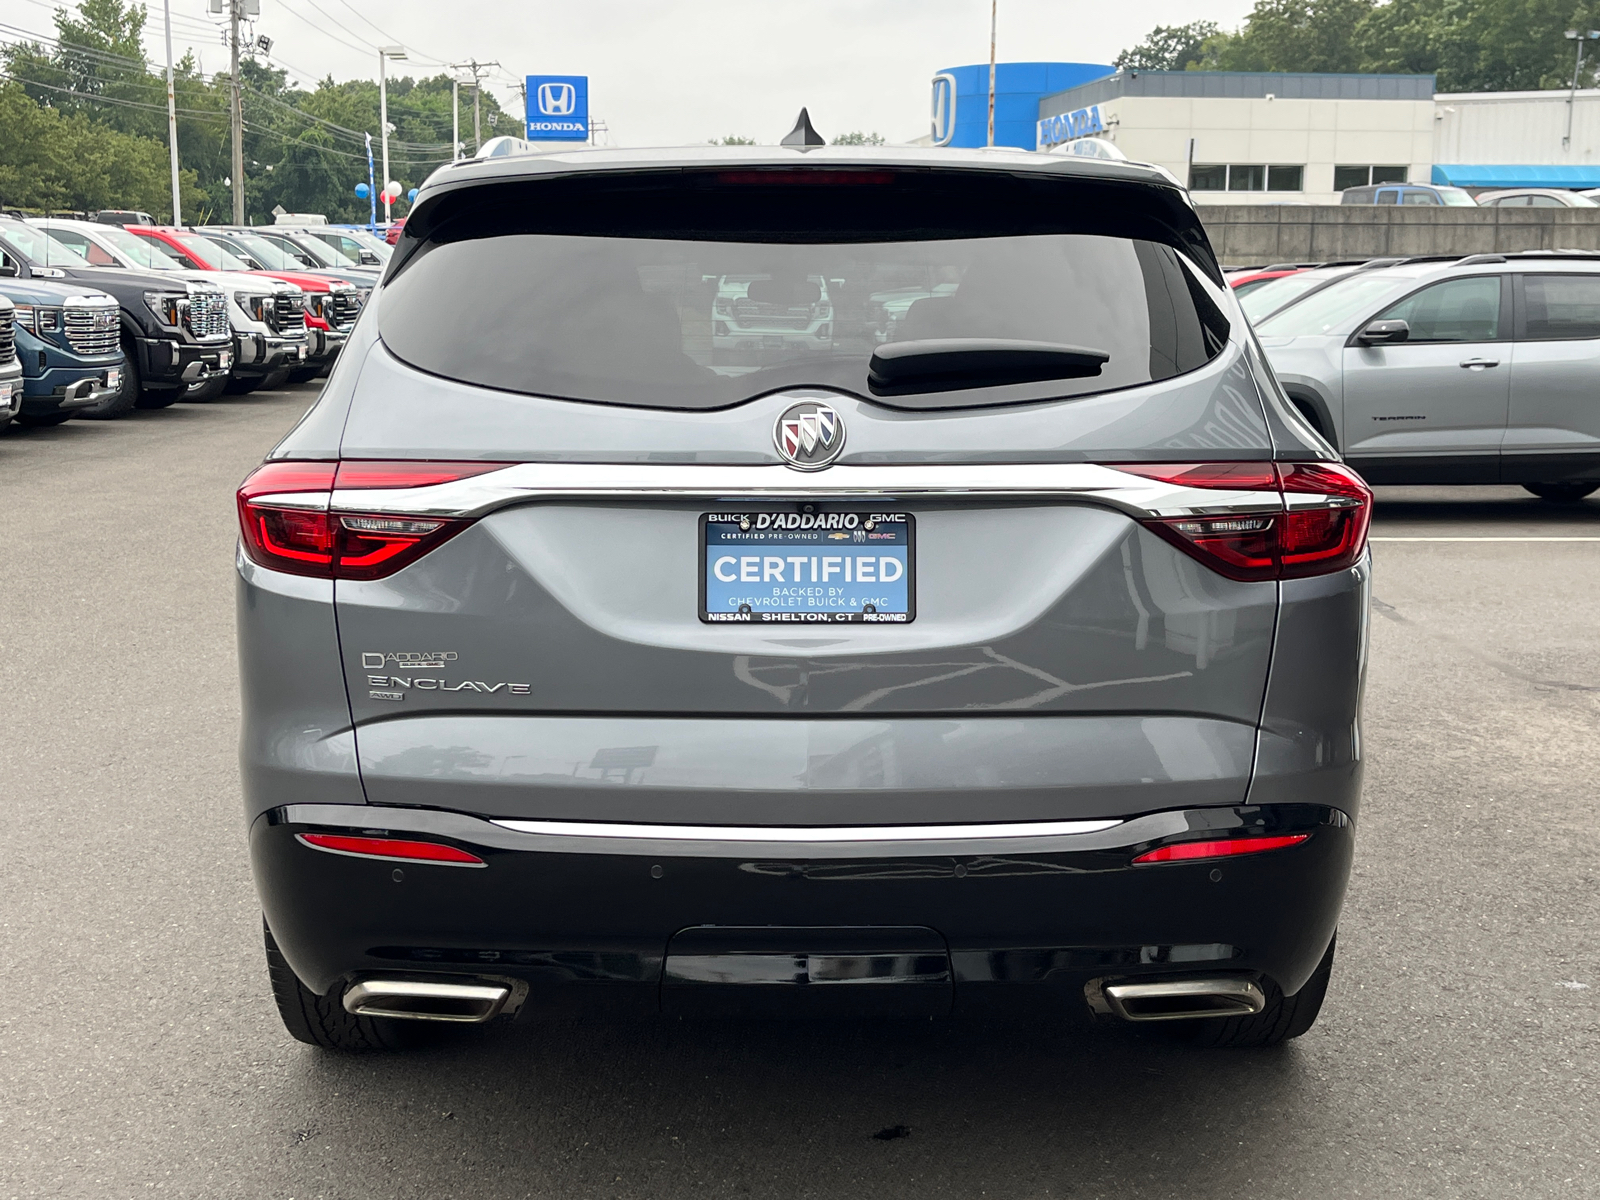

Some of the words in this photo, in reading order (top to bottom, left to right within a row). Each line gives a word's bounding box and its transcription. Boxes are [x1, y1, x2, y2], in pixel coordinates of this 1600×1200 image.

[529, 122, 586, 131] HONDA
[1039, 105, 1103, 146] HONDA
[708, 514, 750, 522] BUICK
[756, 513, 859, 530] D'ADDARIO
[870, 514, 906, 522] GMC
[713, 556, 903, 582] CERTIFIED
[772, 587, 823, 596] BACKED
[828, 587, 844, 596] BY
[728, 597, 802, 606] CHEVROLET
[808, 597, 846, 606] BUICK
[849, 597, 858, 606] &
[861, 597, 888, 606] GMC
[708, 613, 750, 621] NISSAN
[761, 613, 832, 622] SHELTON,
[835, 613, 855, 621] CT
[367, 675, 531, 695] ENCLAVE
